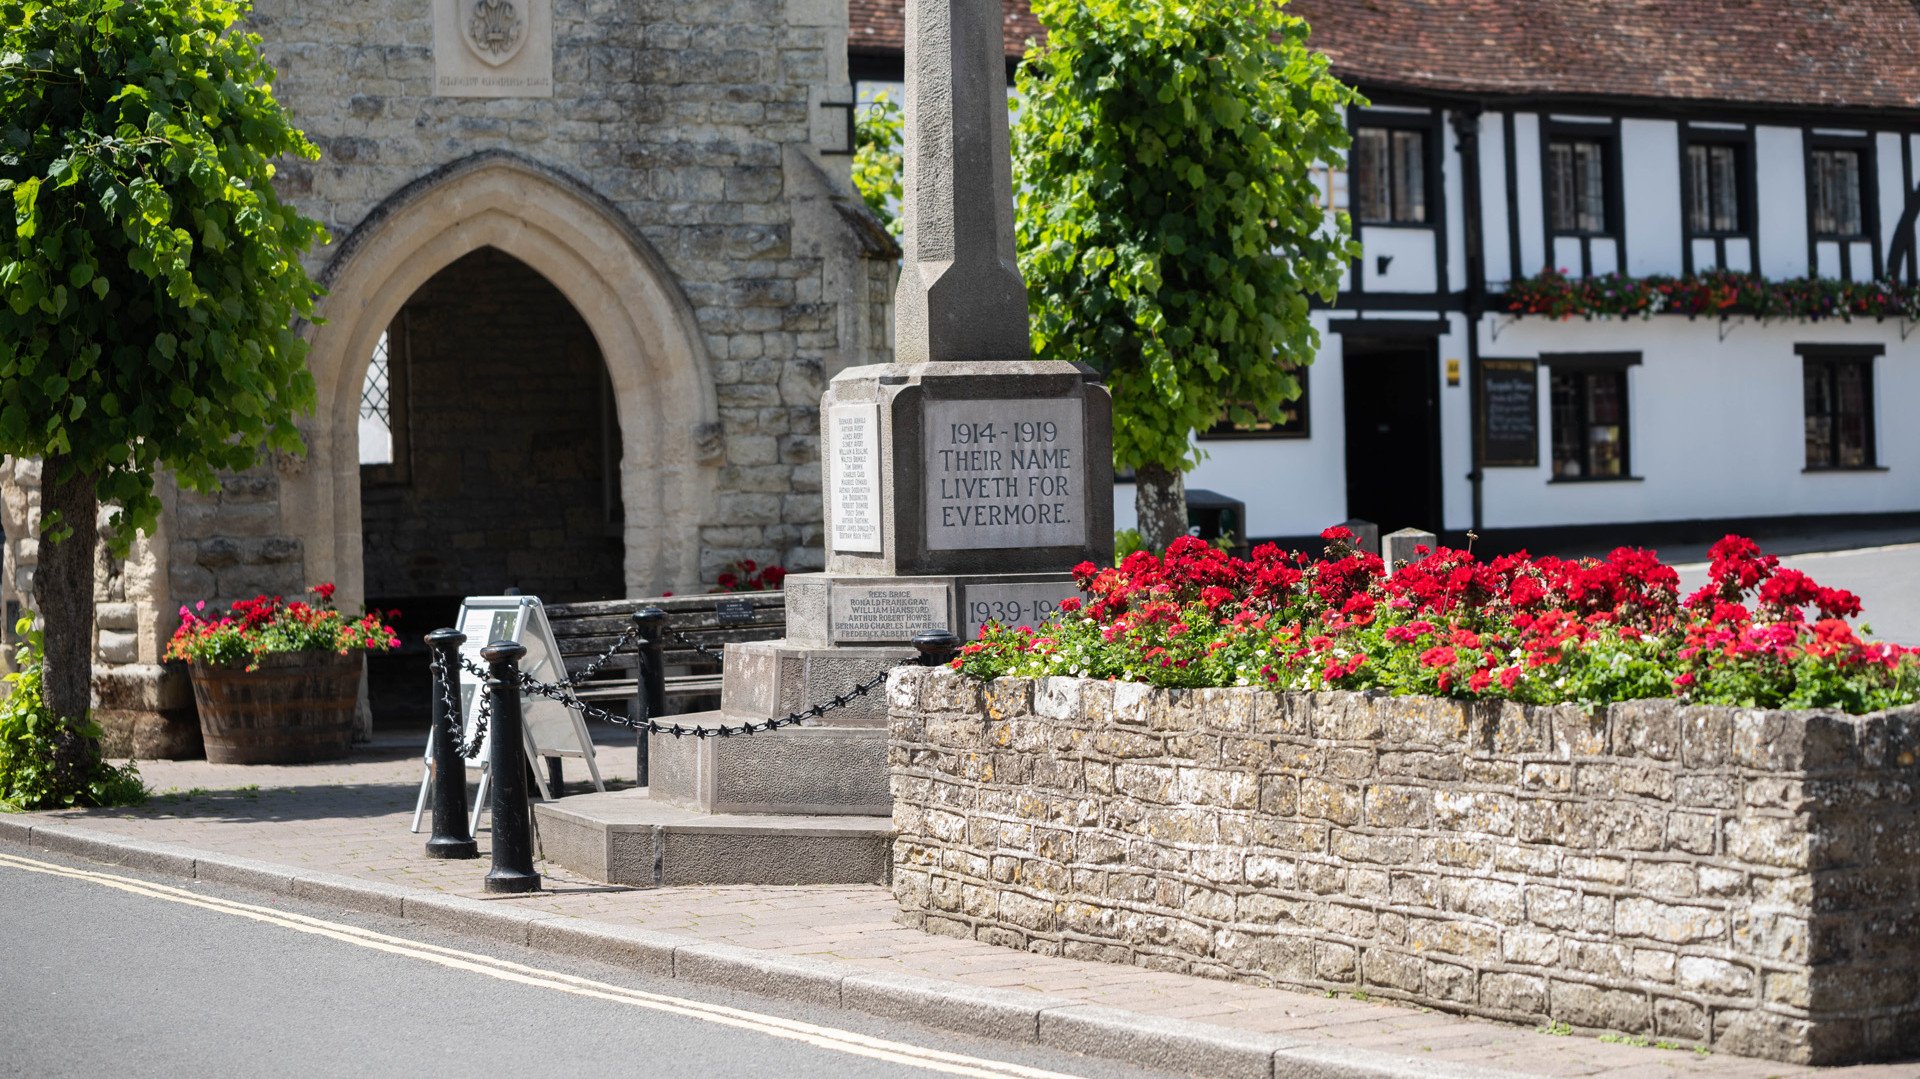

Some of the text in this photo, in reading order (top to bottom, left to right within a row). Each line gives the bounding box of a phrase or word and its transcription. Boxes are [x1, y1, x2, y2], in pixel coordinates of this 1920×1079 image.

[939, 449, 1071, 472] THEIR NAME
[941, 476, 1069, 499] LIVETH FOR
[942, 503, 1071, 527] EVERMORE.
